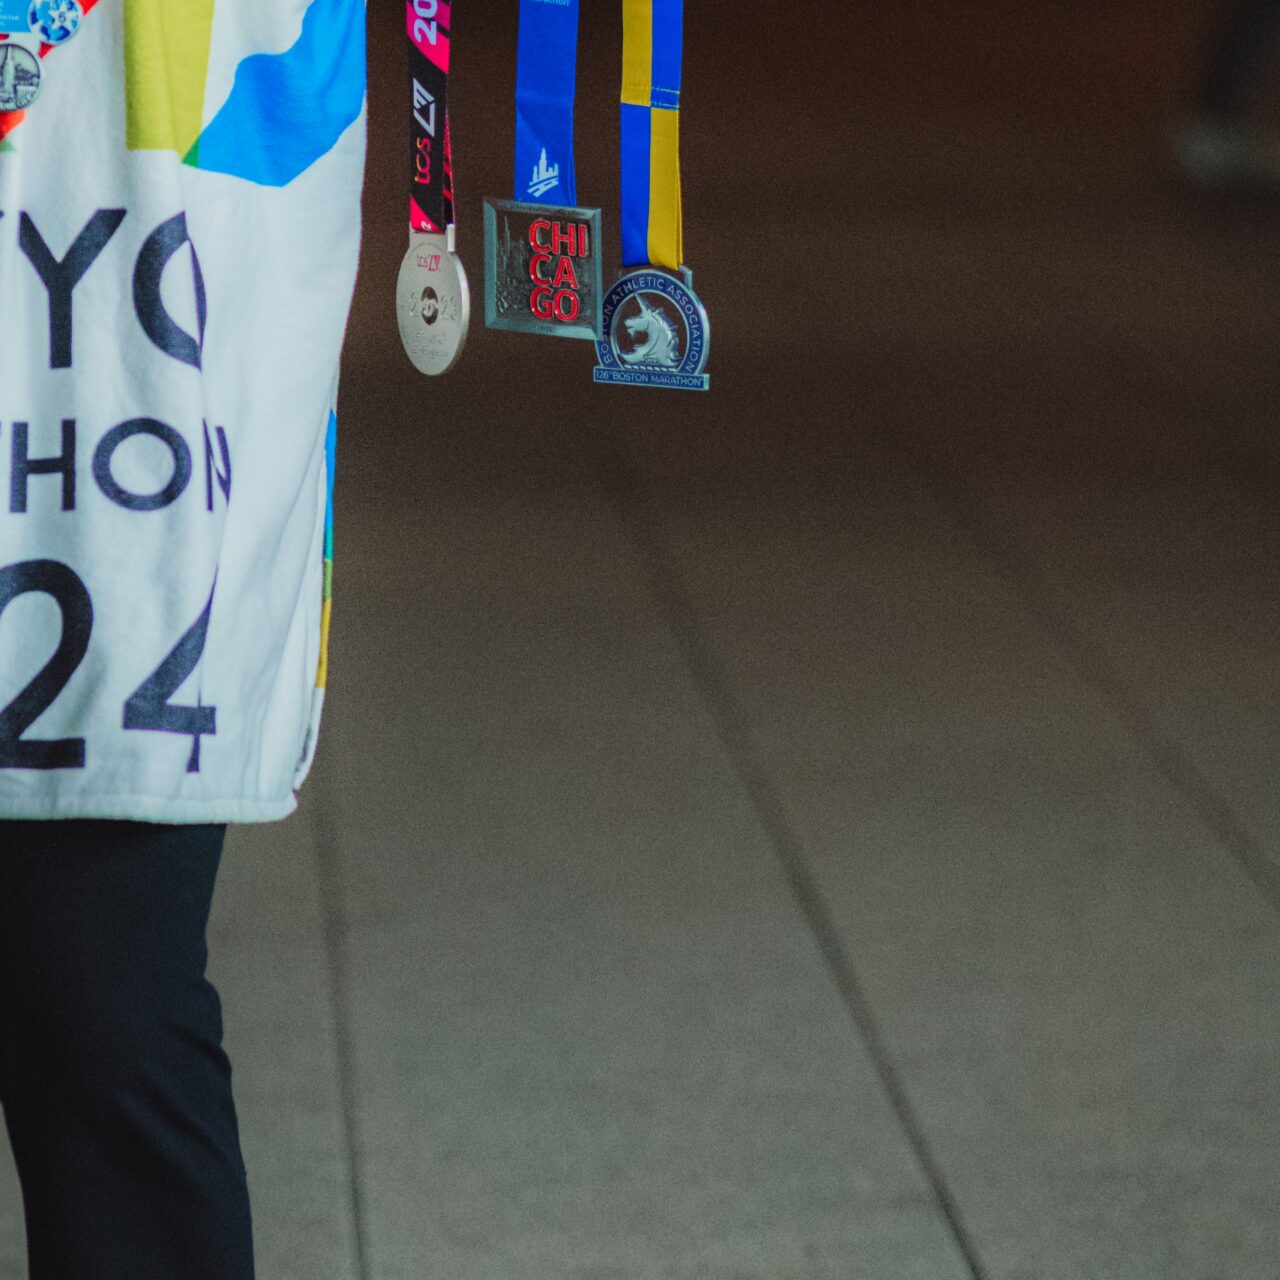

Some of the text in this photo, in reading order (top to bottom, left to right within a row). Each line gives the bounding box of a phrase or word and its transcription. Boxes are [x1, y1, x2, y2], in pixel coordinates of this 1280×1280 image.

[414, 137, 431, 185] tcs
[528, 219, 588, 258] CHI
[528, 252, 580, 290] CA
[529, 287, 580, 322] GO
[600, 276, 701, 372] BOON ATHLETIC ASSOCIATION
[612, 371, 649, 382] BOSTON
[651, 375, 701, 386] MARATHON
